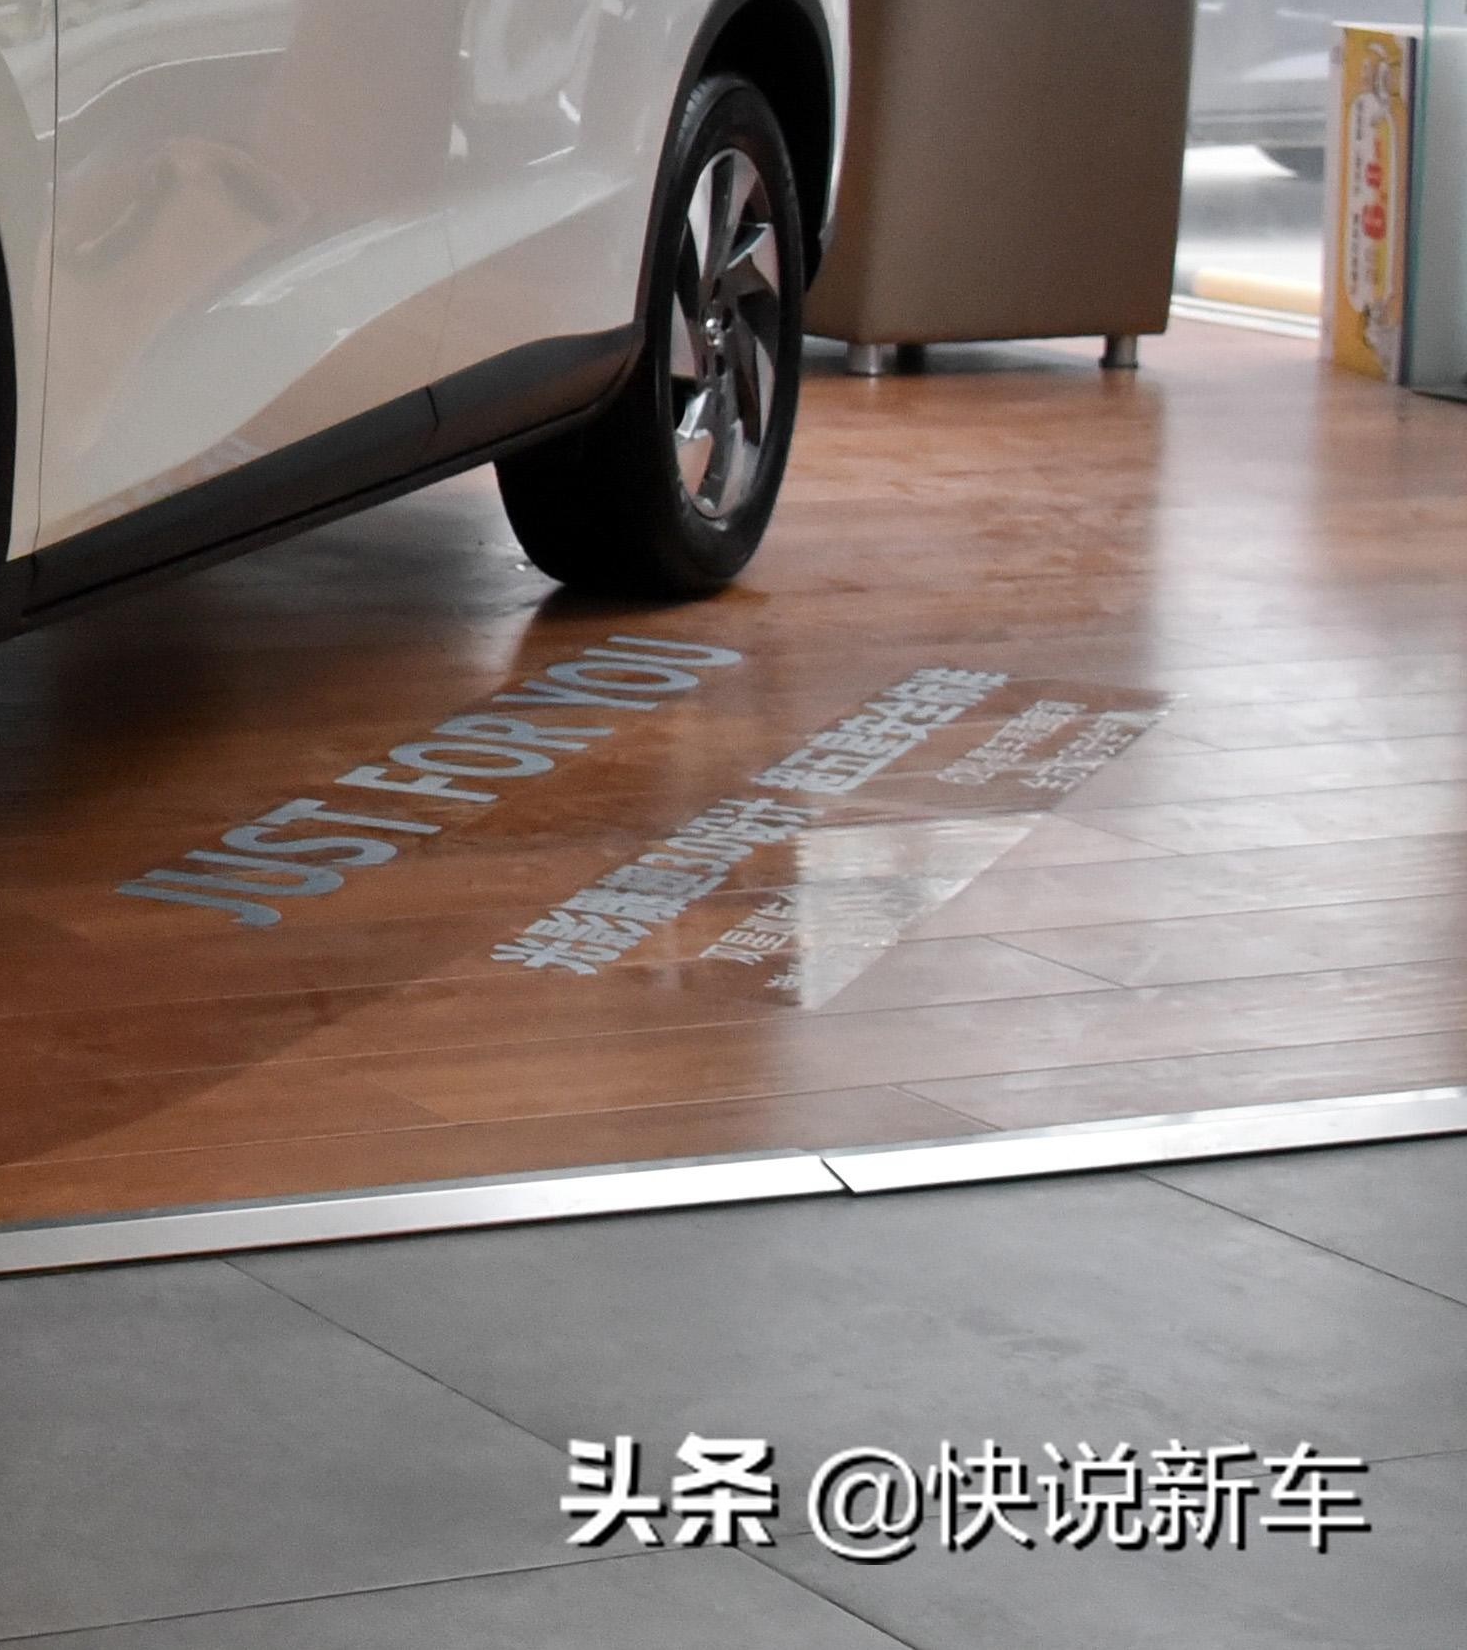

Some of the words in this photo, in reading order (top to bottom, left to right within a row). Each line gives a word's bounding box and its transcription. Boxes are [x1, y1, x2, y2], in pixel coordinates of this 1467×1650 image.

[114, 797, 443, 929] JUST
[334, 712, 616, 804] FOR
[491, 634, 744, 712] YOU
